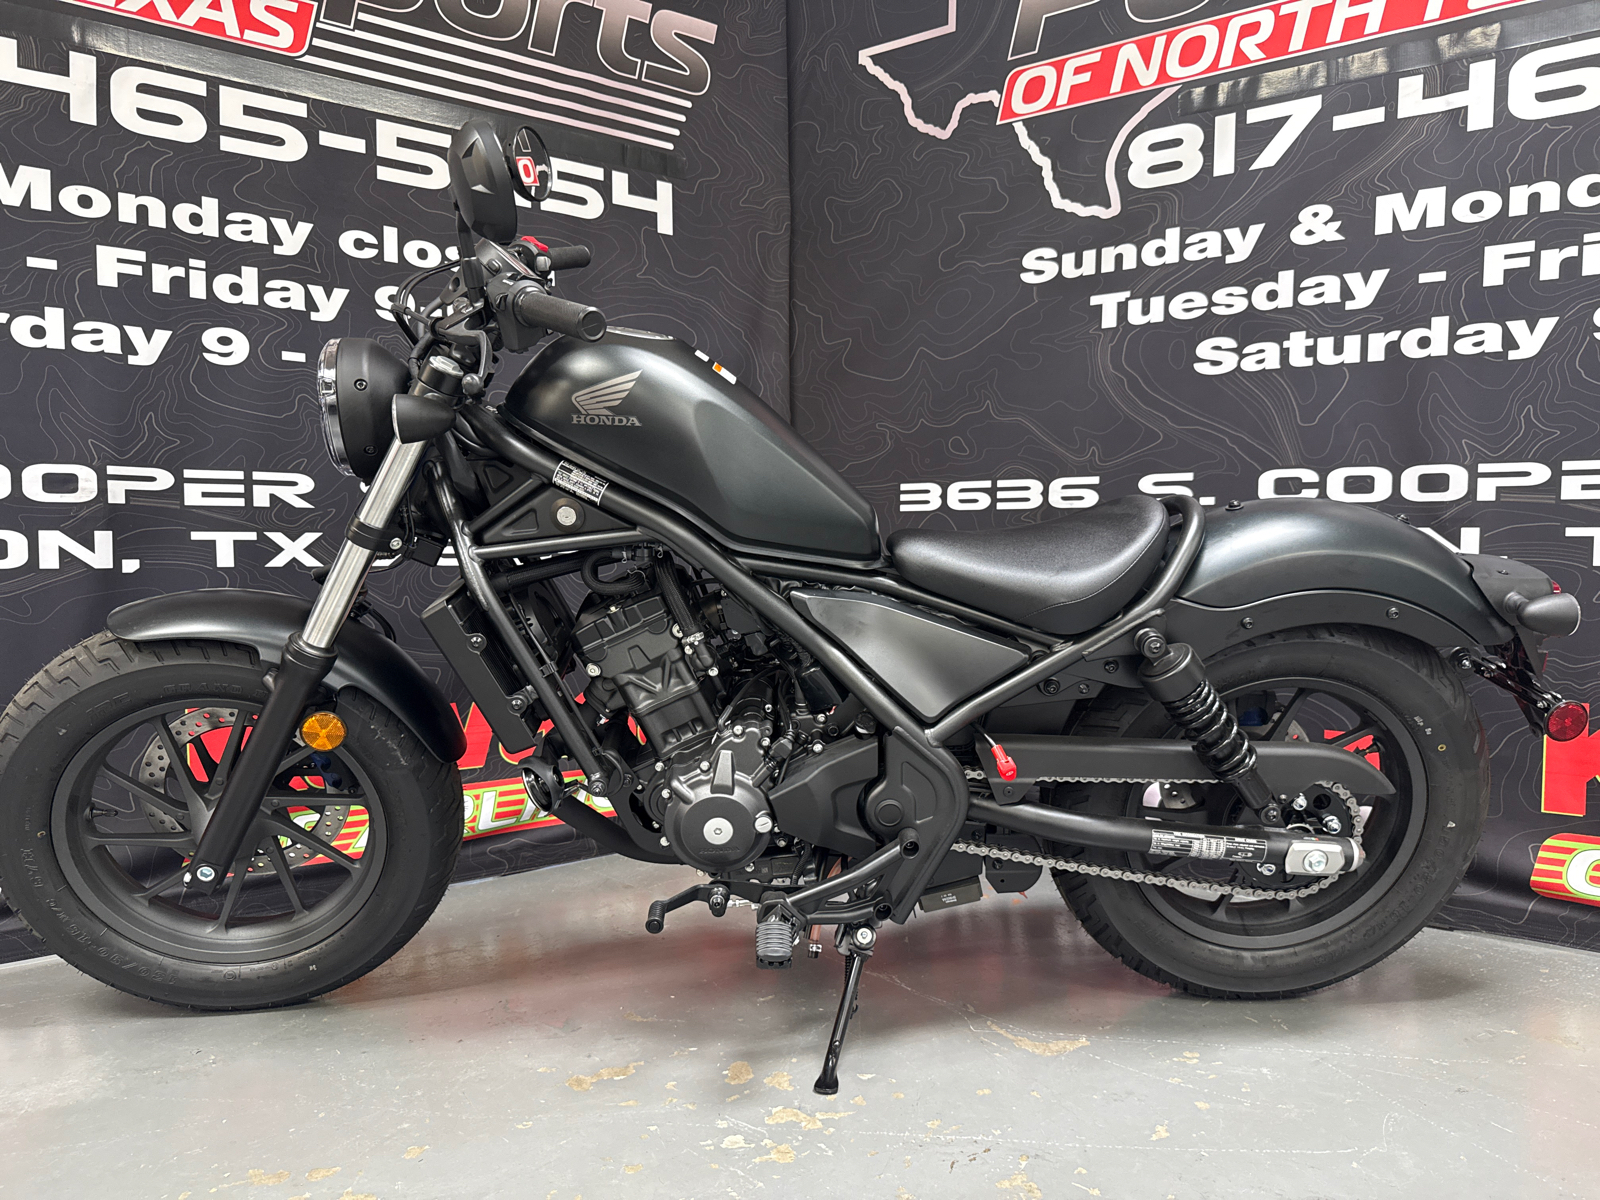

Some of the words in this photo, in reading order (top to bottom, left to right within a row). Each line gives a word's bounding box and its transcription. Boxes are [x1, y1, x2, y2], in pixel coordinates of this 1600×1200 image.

[78, 0, 298, 49] AS
[1010, 52, 1101, 115] OF
[1109, 0, 1389, 94] NORTH
[0, 36, 673, 236] 465-554
[0, 162, 314, 256] Monday
[1020, 226, 1266, 284] Sunday
[1289, 203, 1346, 246] &
[96, 244, 350, 322] Friday
[1090, 268, 1390, 330] Tuesday
[1482, 231, 1600, 288] Fri
[0, 306, 173, 366] day
[201, 326, 250, 366] 9
[1193, 316, 1560, 376] Saturday
[571, 414, 642, 427] HONDA
[0, 463, 315, 509] OPER
[900, 475, 1100, 512] 3636
[190, 531, 324, 568] TX
